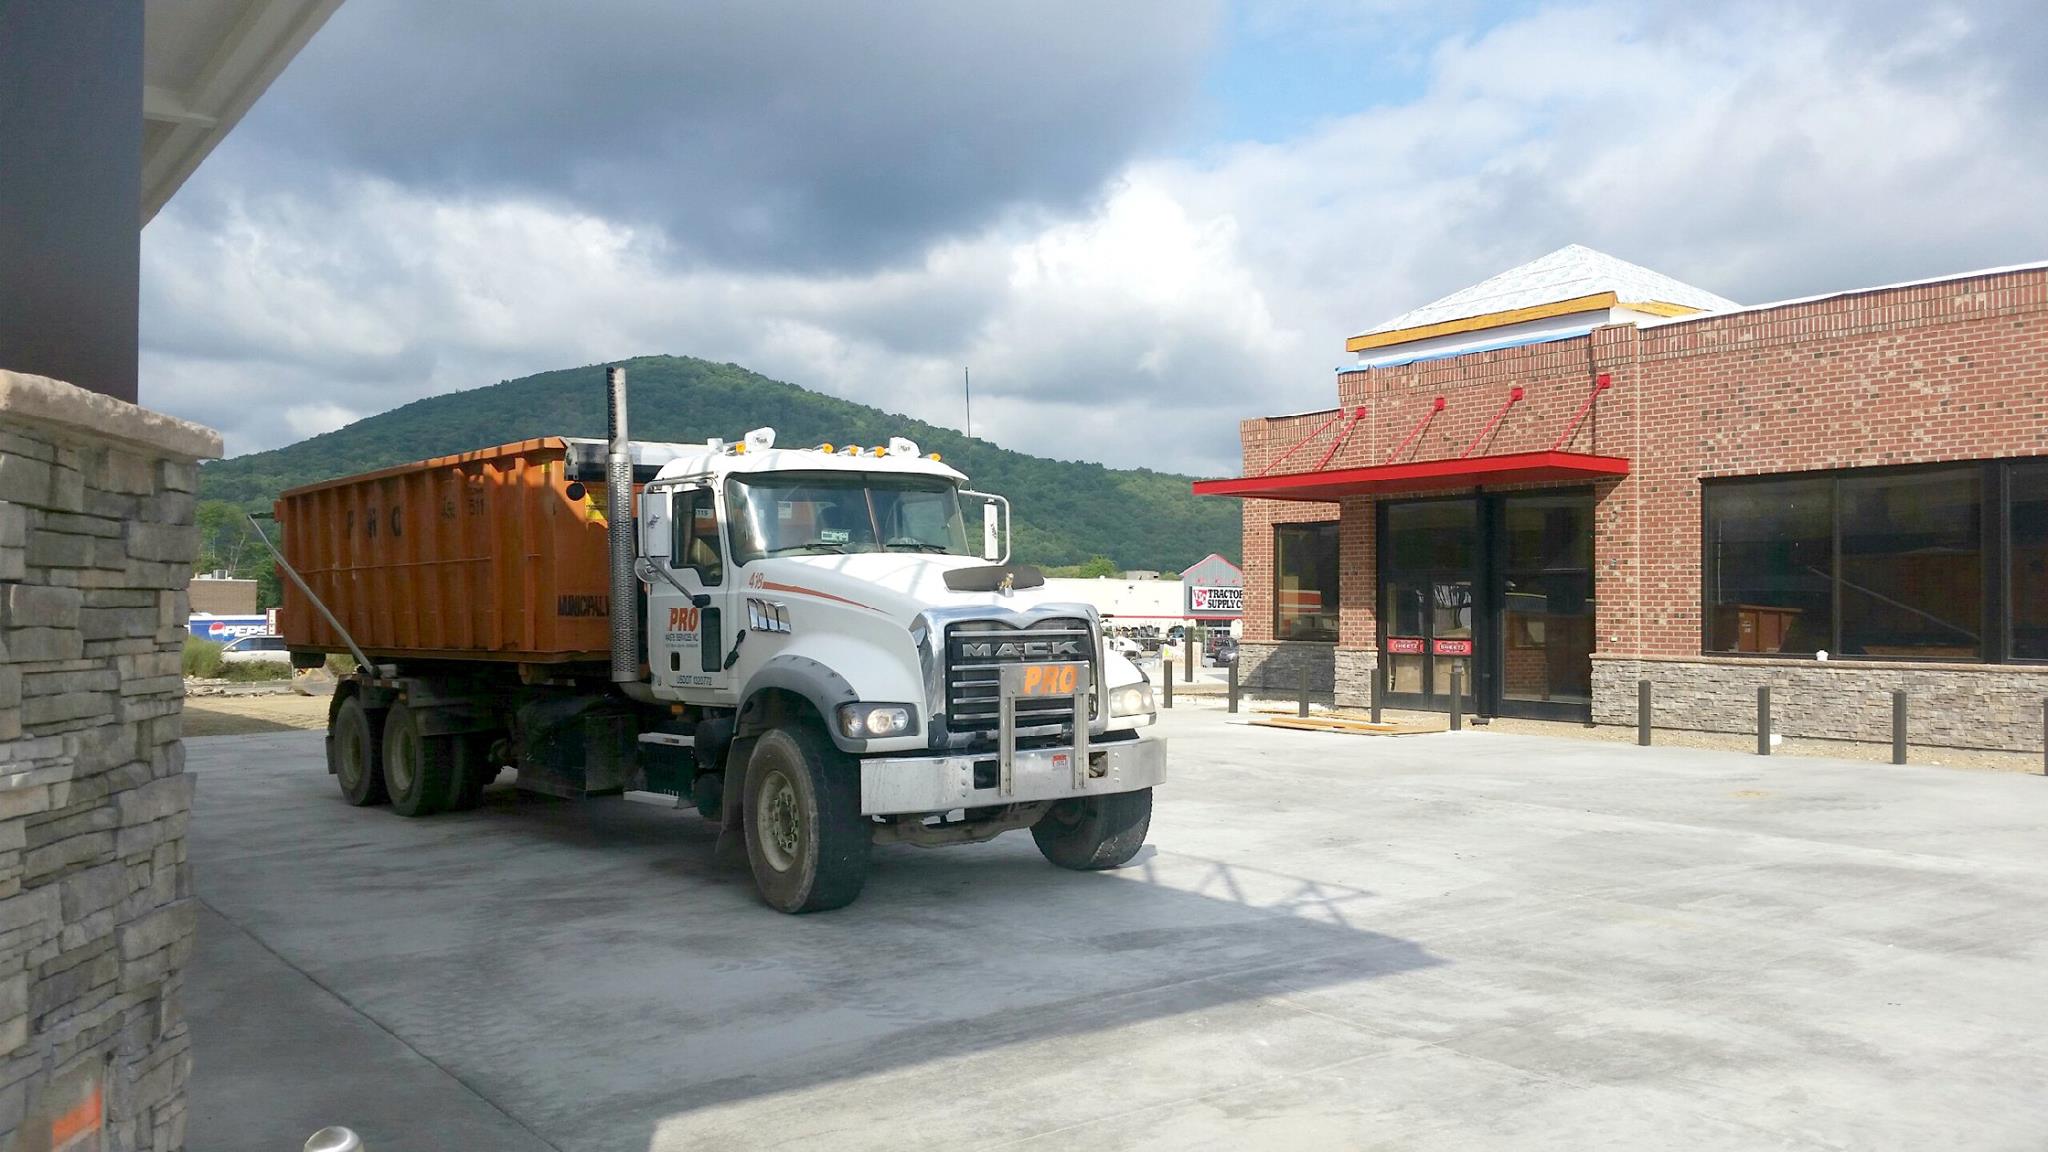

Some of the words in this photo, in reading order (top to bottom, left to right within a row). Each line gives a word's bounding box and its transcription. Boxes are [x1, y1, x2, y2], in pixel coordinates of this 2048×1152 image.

[1208, 599, 1235, 608] SUPPLY
[669, 607, 698, 631] PRO
[225, 625, 267, 637] PEPS
[962, 641, 1081, 657] MACK
[1024, 665, 1077, 694] PRO
